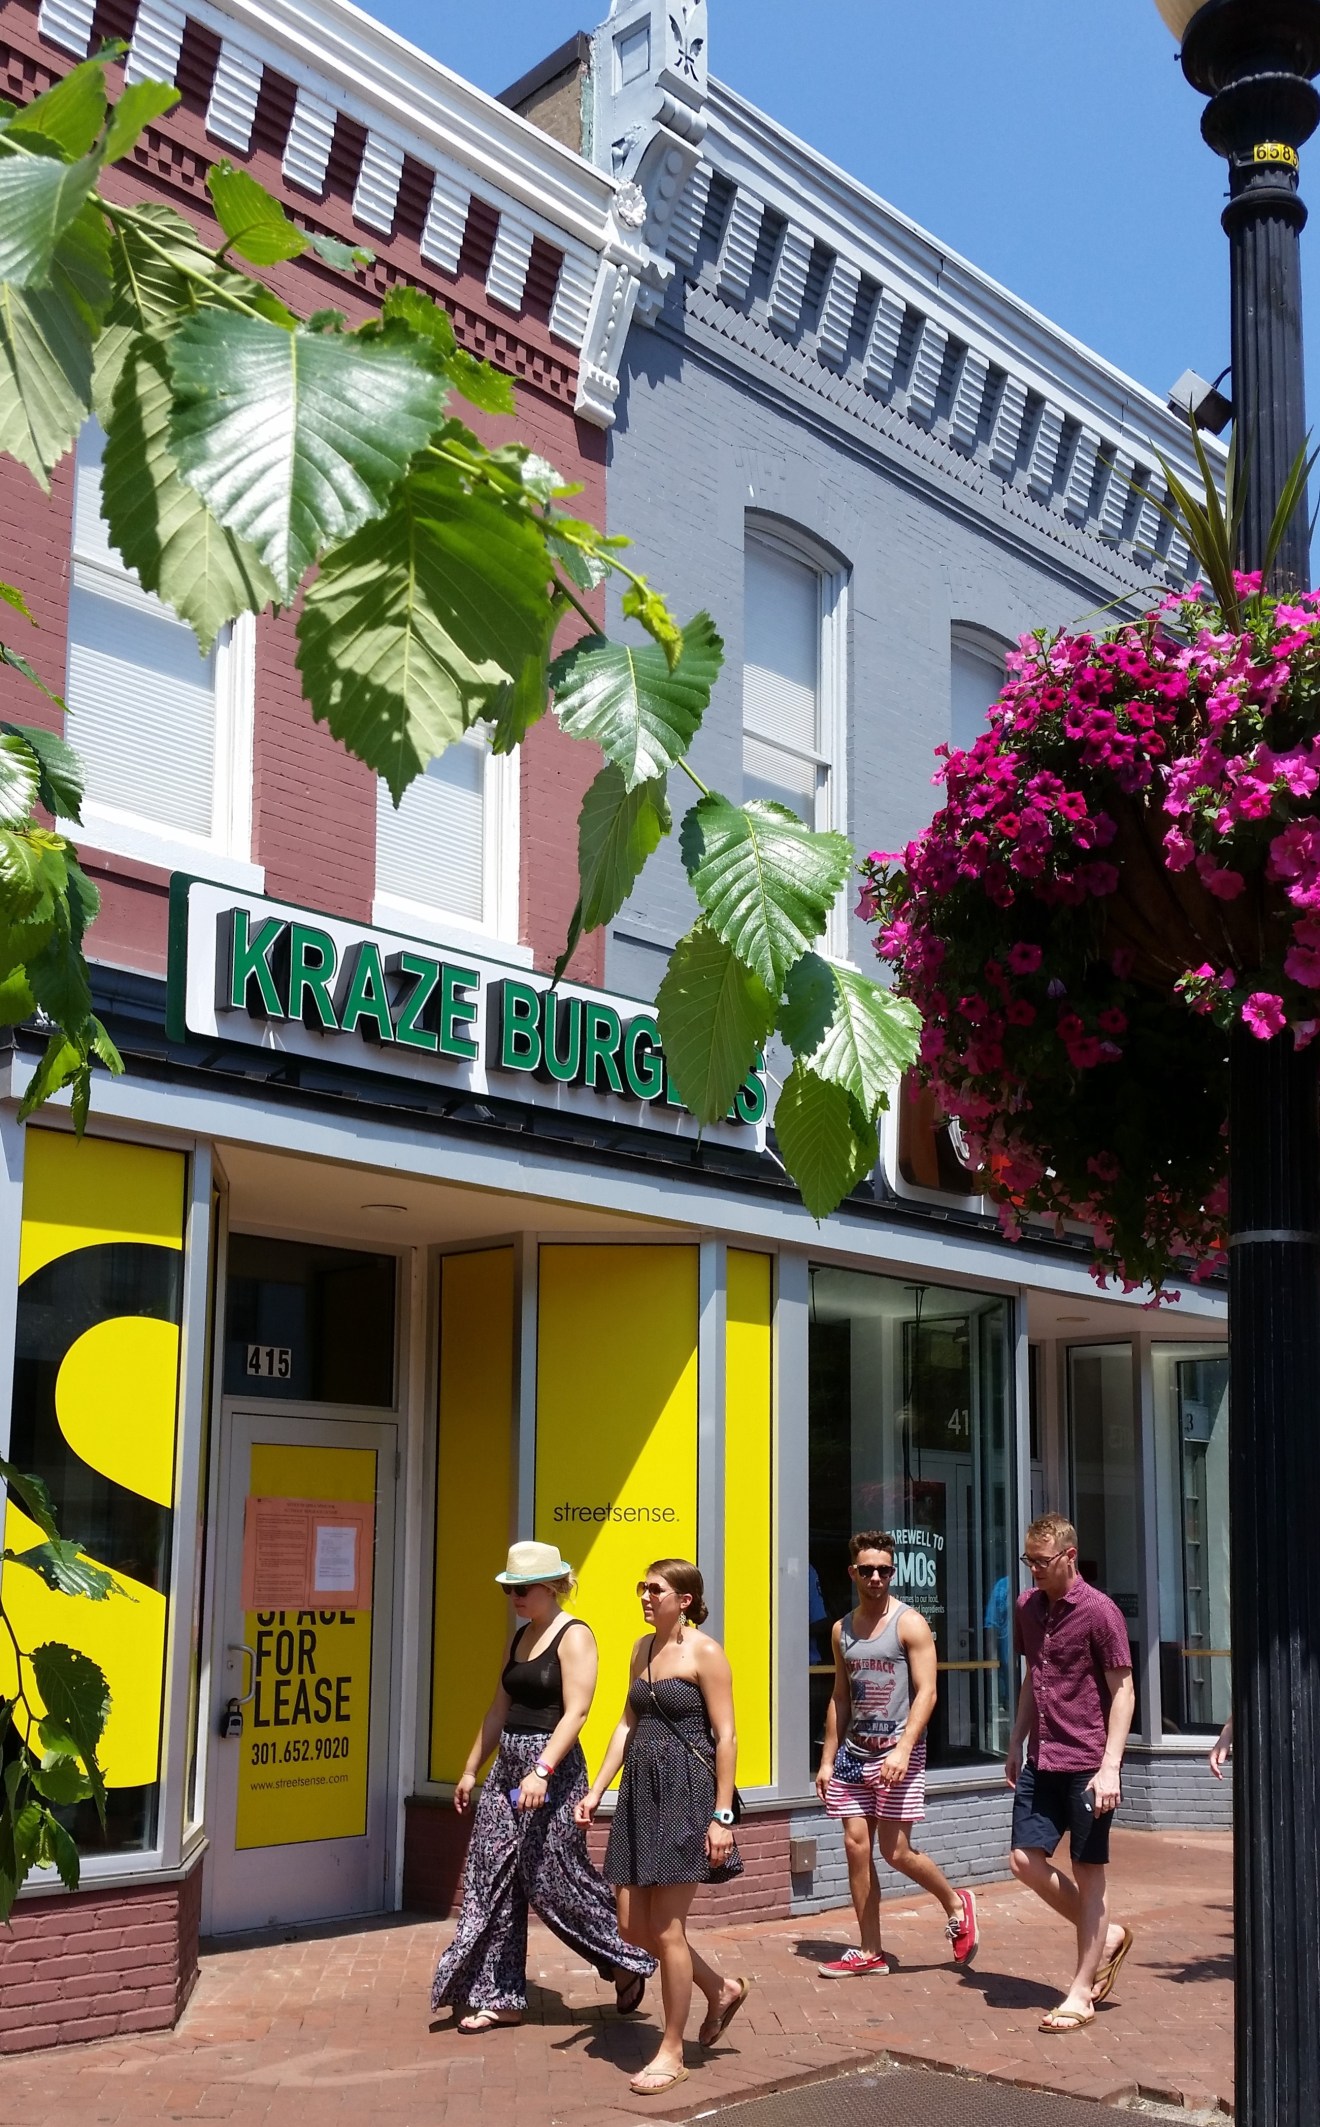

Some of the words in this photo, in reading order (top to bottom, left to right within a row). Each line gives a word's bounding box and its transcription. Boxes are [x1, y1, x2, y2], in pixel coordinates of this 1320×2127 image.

[229, 906, 480, 1061] KRAZE
[502, 978, 767, 1125] BURGS
[249, 1346, 290, 1377] 415
[553, 1502, 680, 1523] streetsense.
[933, 1533, 944, 1551] TO
[256, 1629, 317, 1677] FOR
[870, 1658, 896, 1676] BACK
[254, 1676, 351, 1728] LEASE
[251, 1736, 349, 1766] 301.652.9020
[250, 1773, 349, 1791] www.streetsense.com
